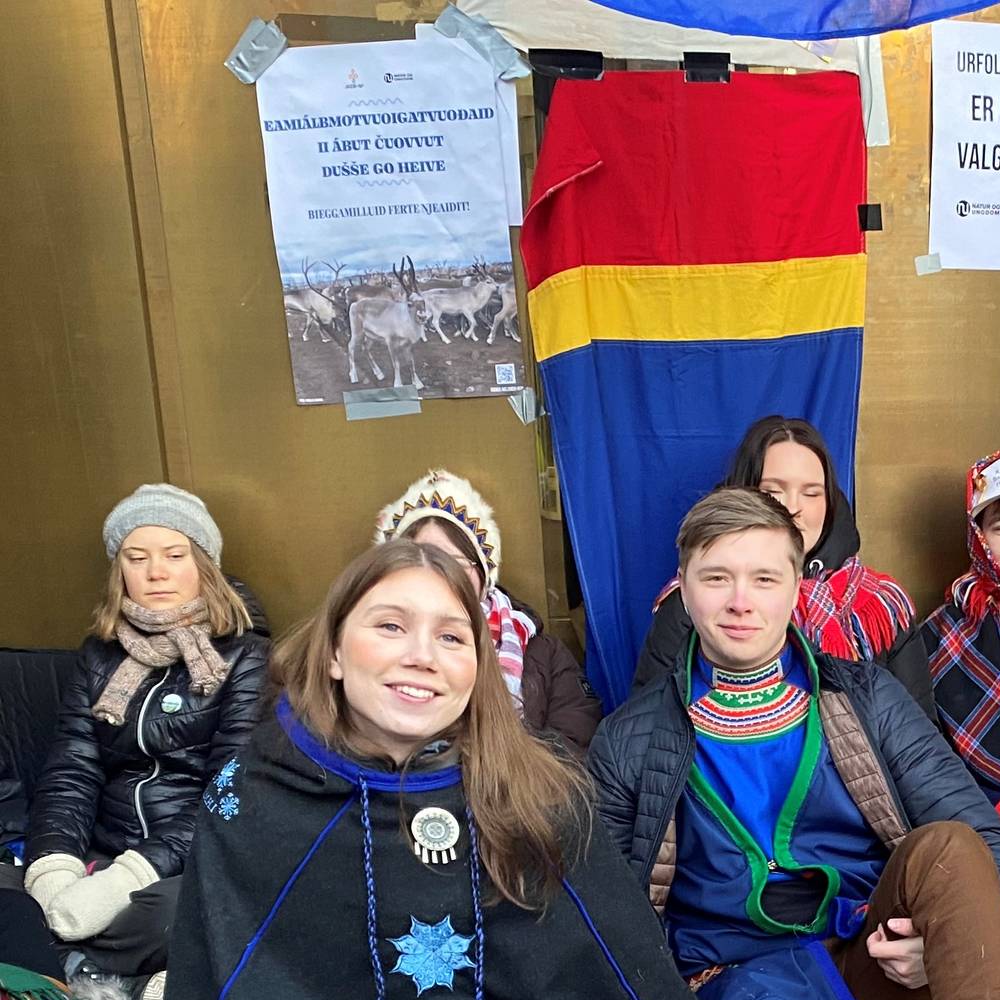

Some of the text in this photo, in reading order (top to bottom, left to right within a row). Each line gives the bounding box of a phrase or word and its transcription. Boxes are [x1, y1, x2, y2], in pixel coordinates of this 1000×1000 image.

[971, 95, 994, 122] ER
[332, 137, 371, 153] ÁBUT
[374, 135, 444, 150] ČUOVVUT
[321, 160, 446, 178] DUŠŠE GO HEIVE
[388, 204, 420, 216] FERTE
